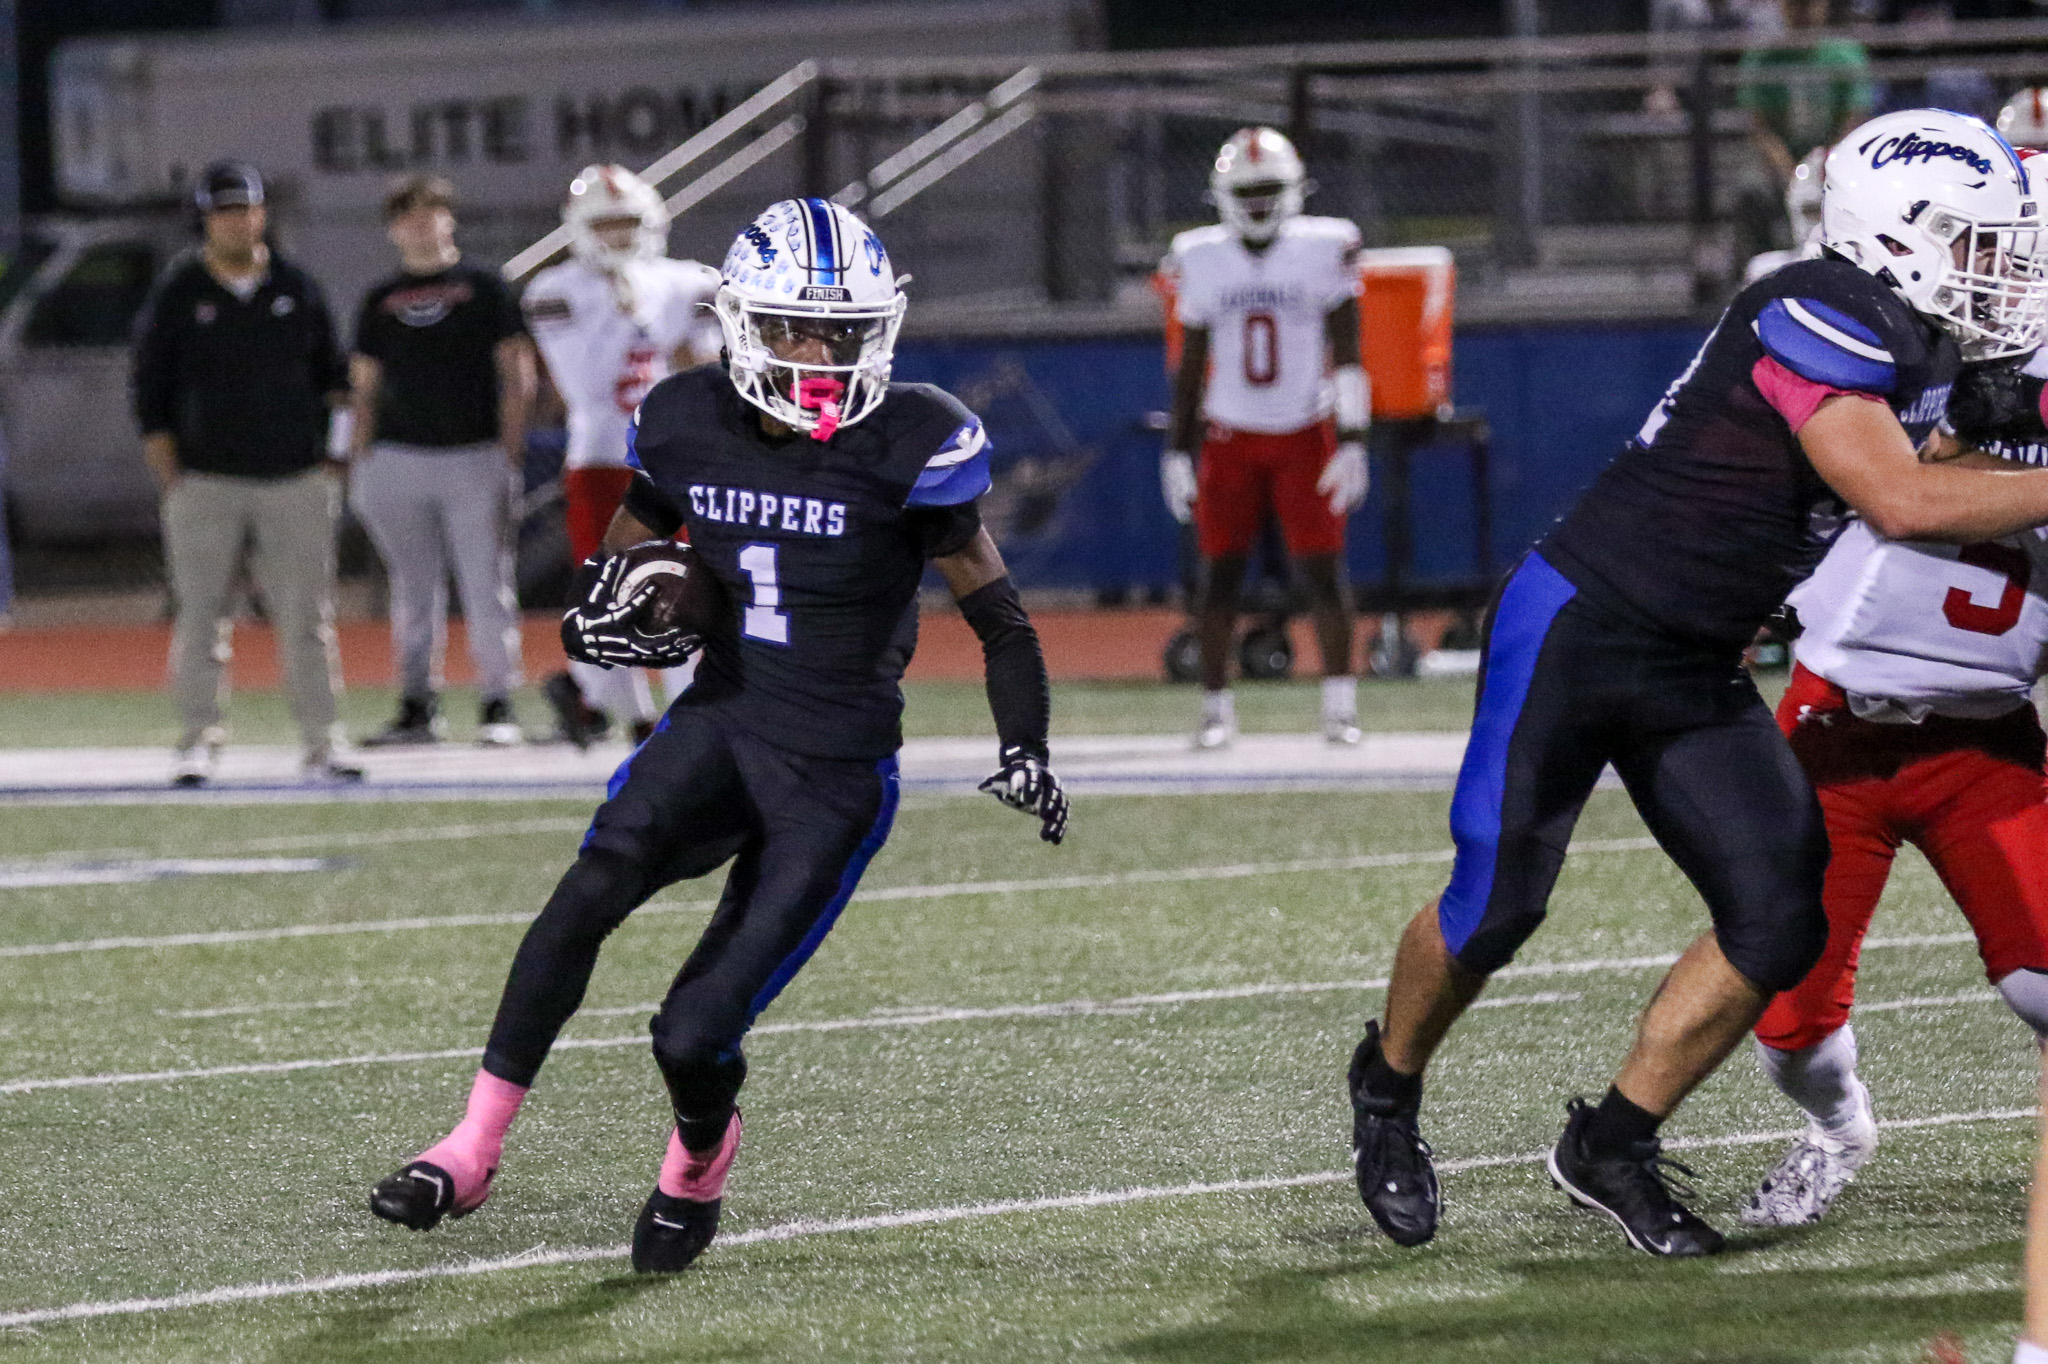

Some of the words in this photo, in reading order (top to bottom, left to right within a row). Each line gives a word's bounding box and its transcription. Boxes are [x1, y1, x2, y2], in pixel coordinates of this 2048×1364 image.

[313, 97, 526, 171] ELITE
[1871, 132, 1994, 174] Clippers
[805, 286, 844, 301] FINISH
[1243, 312, 1280, 386] 0
[688, 485, 847, 537] CLIPPERS
[737, 542, 789, 645] 1
